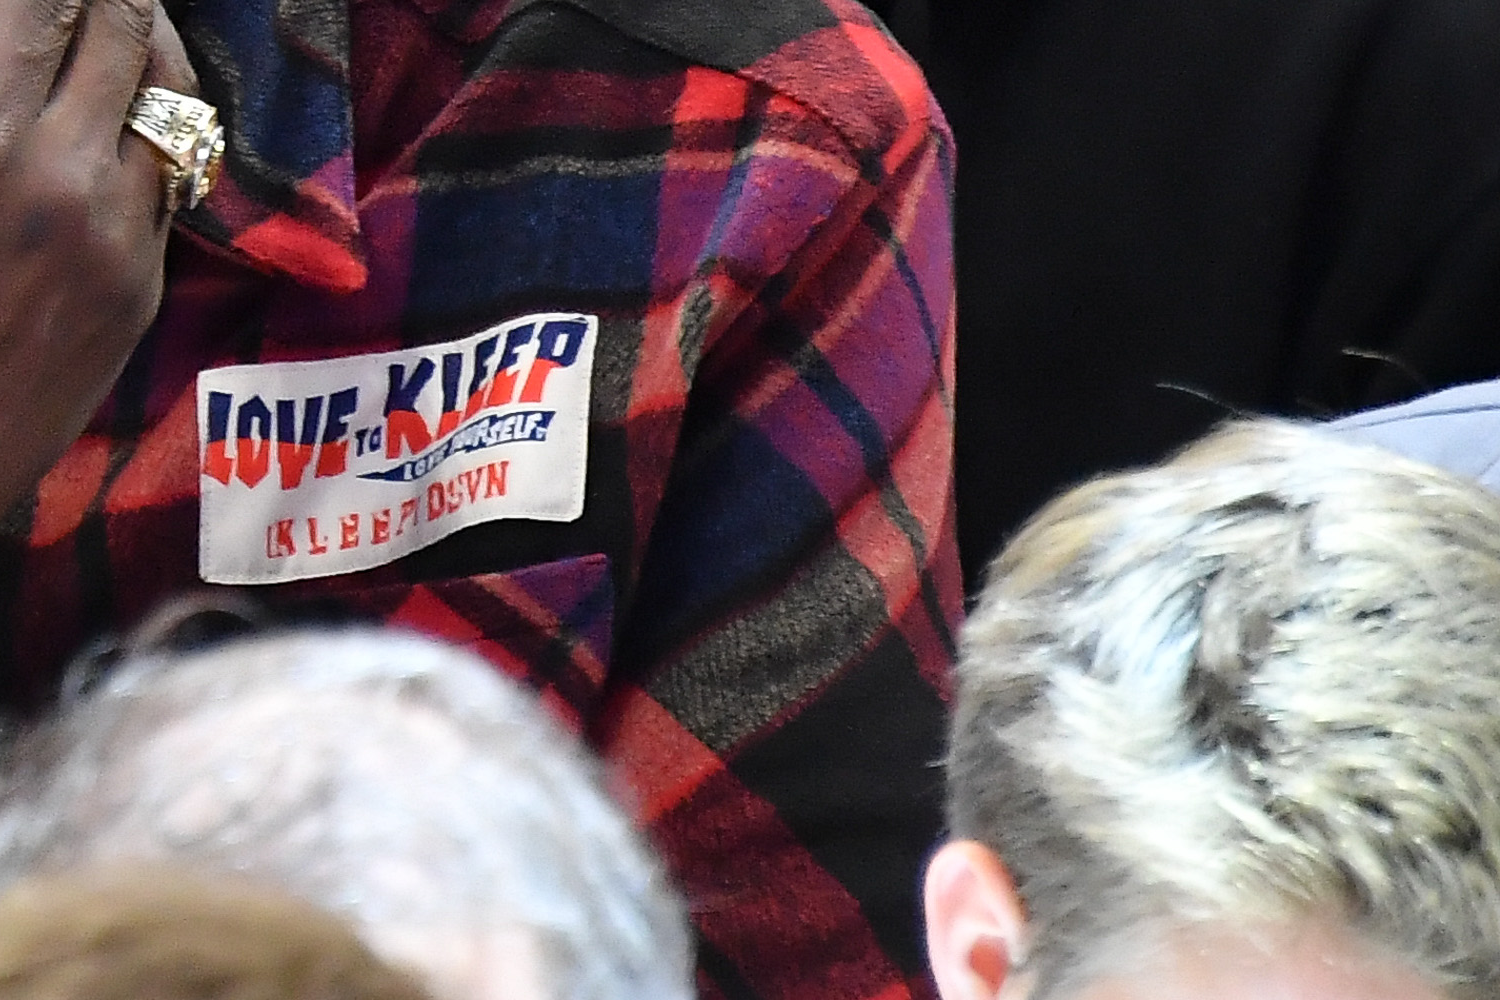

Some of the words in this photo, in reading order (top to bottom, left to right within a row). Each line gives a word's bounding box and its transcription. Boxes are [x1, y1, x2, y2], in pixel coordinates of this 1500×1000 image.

[204, 386, 358, 490] LOVE
[355, 424, 383, 458] TO
[383, 318, 590, 459] KLEEP
